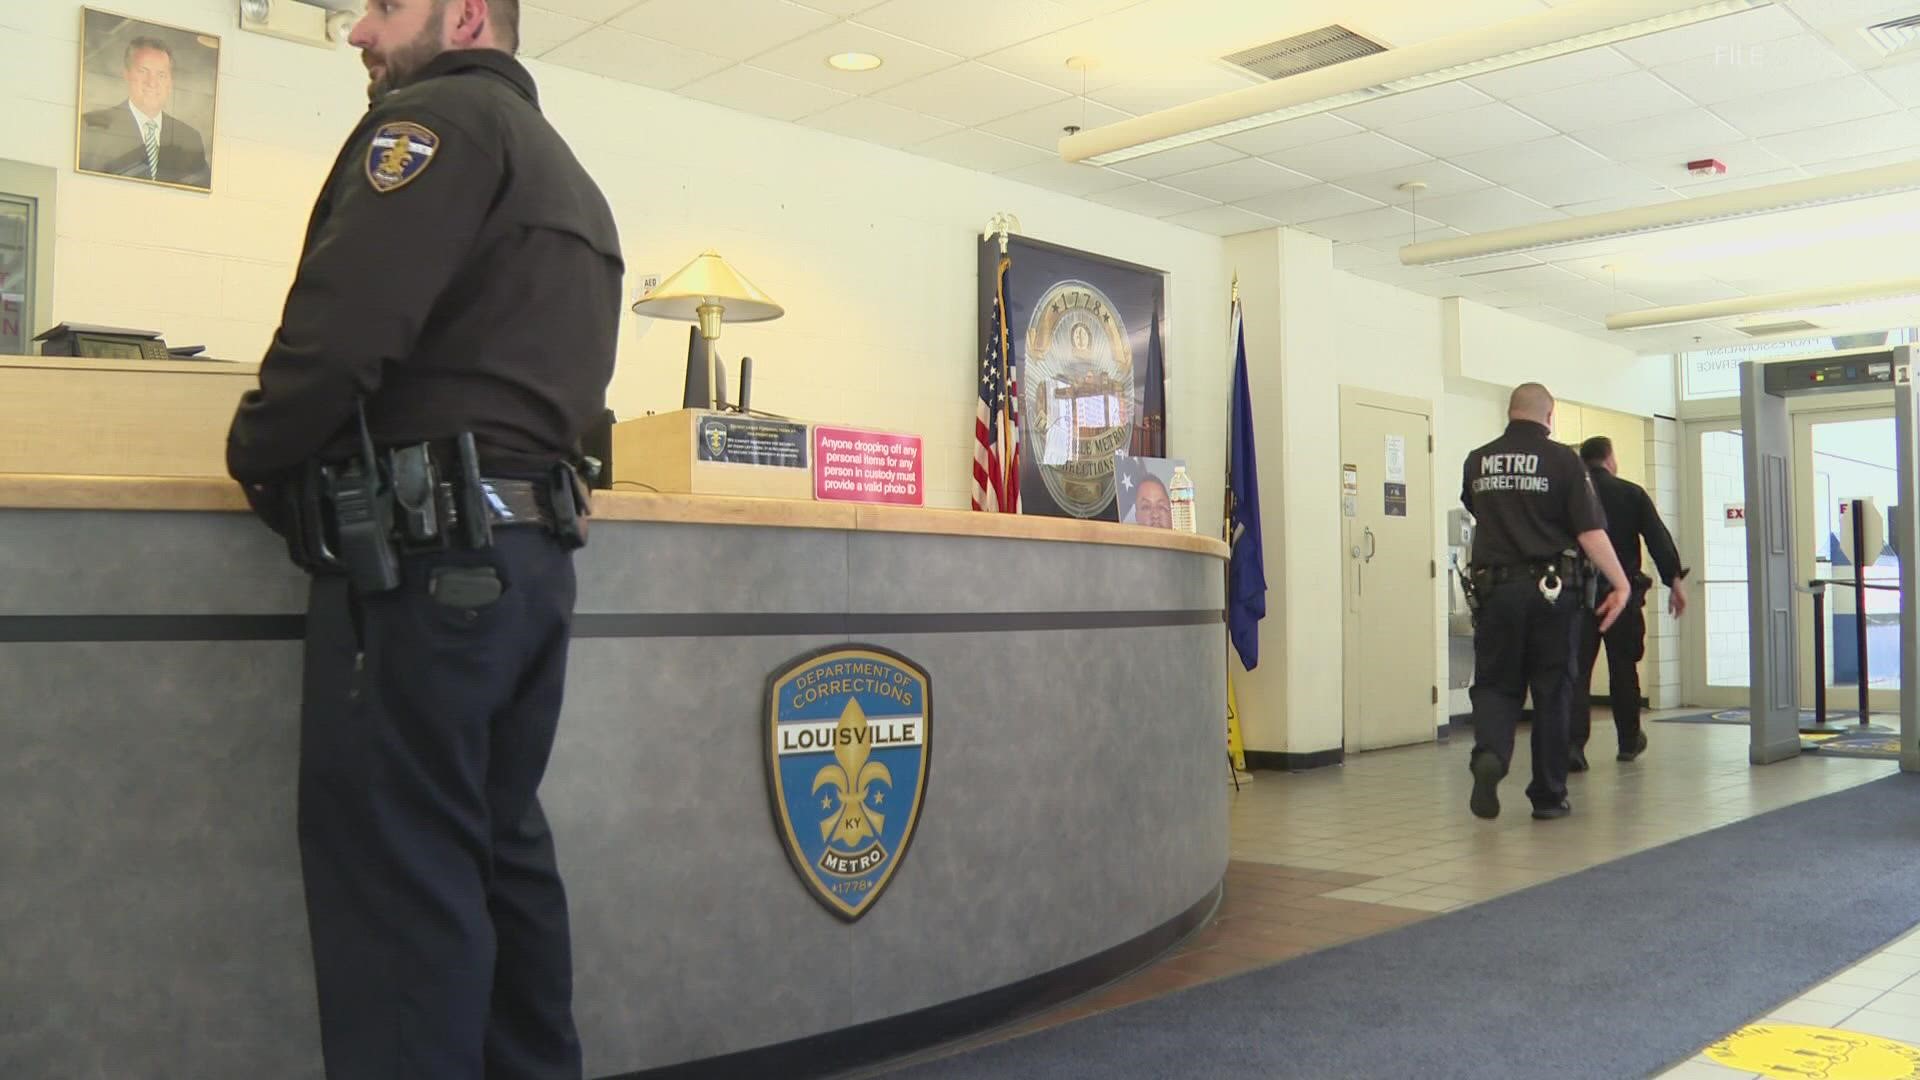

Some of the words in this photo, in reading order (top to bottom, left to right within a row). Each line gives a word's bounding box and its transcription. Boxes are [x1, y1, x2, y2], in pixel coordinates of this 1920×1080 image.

[644, 278, 657, 287] AED
[1060, 292, 1101, 316] 1778
[822, 436, 853, 451] Anyone
[854, 440, 889, 456] dropping
[890, 444, 902, 455] off
[903, 446, 917, 458] any
[826, 452, 862, 464] personal
[864, 454, 885, 467] items
[887, 456, 898, 467] for
[899, 458, 913, 470] any
[1481, 454, 1539, 475] METRO
[824, 466, 853, 477] person
[855, 467, 863, 477] in
[864, 468, 896, 482] custody
[897, 471, 916, 482] must
[825, 479, 855, 491] provide
[864, 481, 882, 492] valid
[884, 483, 906, 495] photo
[907, 485, 916, 495] ID
[796, 663, 892, 690] DEPARTMENT
[893, 672, 913, 688] OF
[793, 678, 913, 709] CORRECTIONS
[783, 723, 916, 750] LOUISVILLE
[845, 818, 861, 829] KY
[825, 850, 880, 872] METRO
[839, 880, 867, 894] 1778
